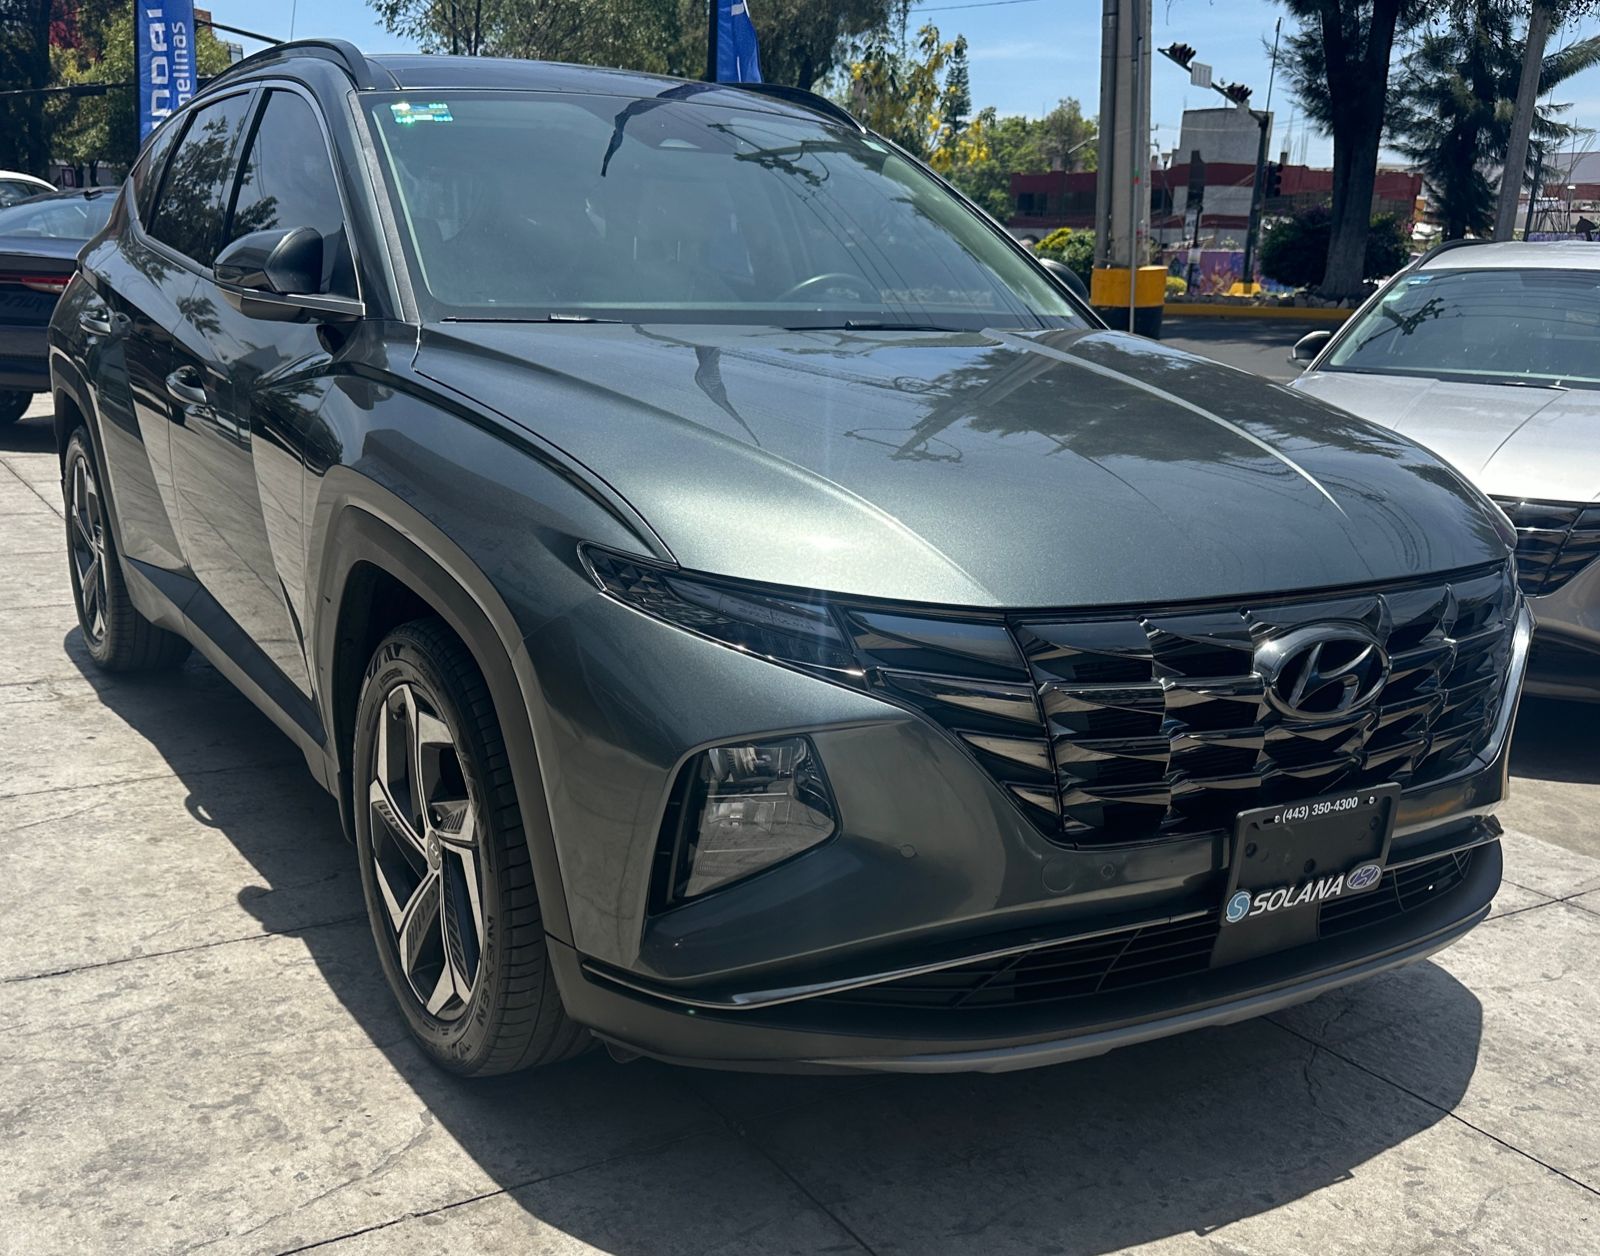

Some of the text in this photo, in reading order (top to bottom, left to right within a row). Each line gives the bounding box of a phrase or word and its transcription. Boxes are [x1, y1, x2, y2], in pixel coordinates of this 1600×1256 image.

[1282, 796, 1358, 823] (443) 350-4300
[1249, 874, 1346, 916] SOLANA
[476, 915, 495, 1027] NEXEN
